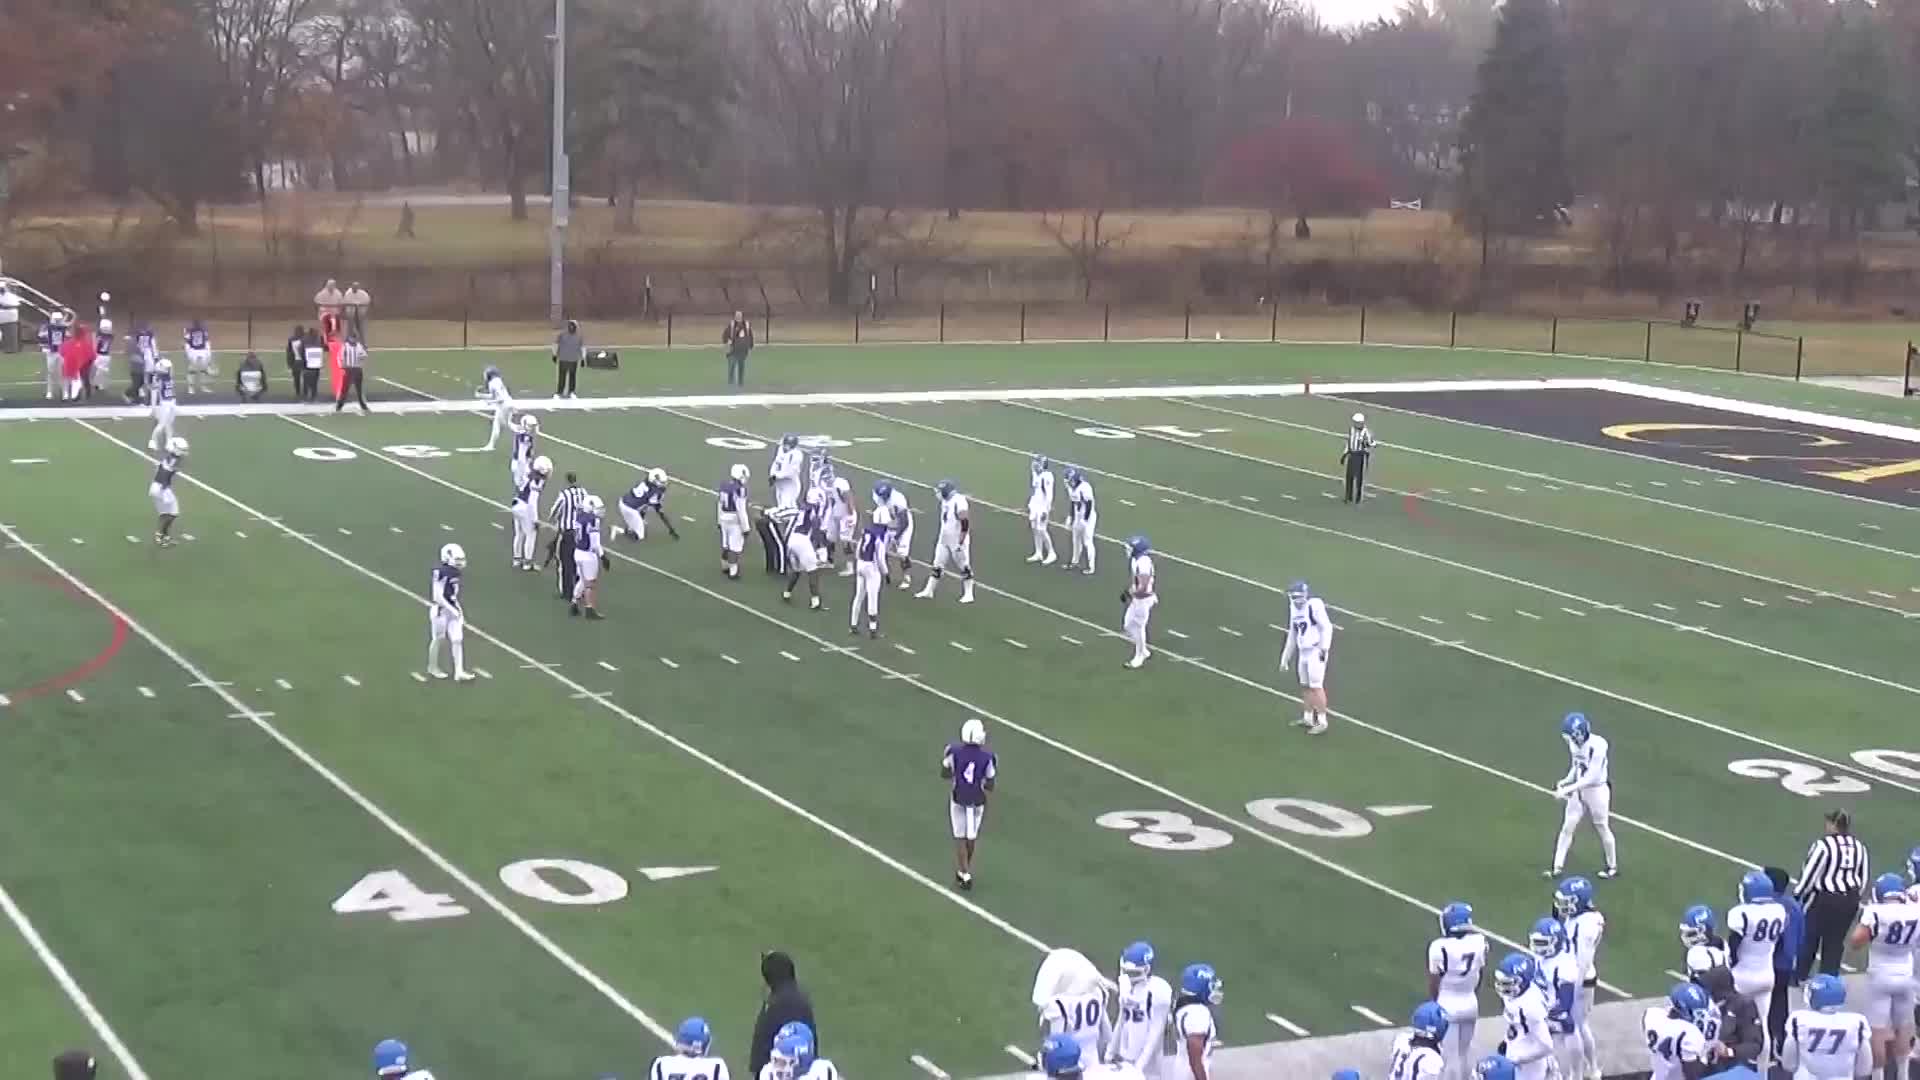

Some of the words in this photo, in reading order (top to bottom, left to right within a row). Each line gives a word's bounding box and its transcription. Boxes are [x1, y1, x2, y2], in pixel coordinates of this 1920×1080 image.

[963, 761, 976, 784] 4
[1095, 798, 1373, 850] 30
[331, 858, 629, 922] 40
[1753, 918, 1782, 942] 80
[1884, 920, 1918, 945] 87
[1461, 952, 1475, 977] 7
[1073, 999, 1100, 1031] 10
[1807, 1028, 1847, 1056] 77
